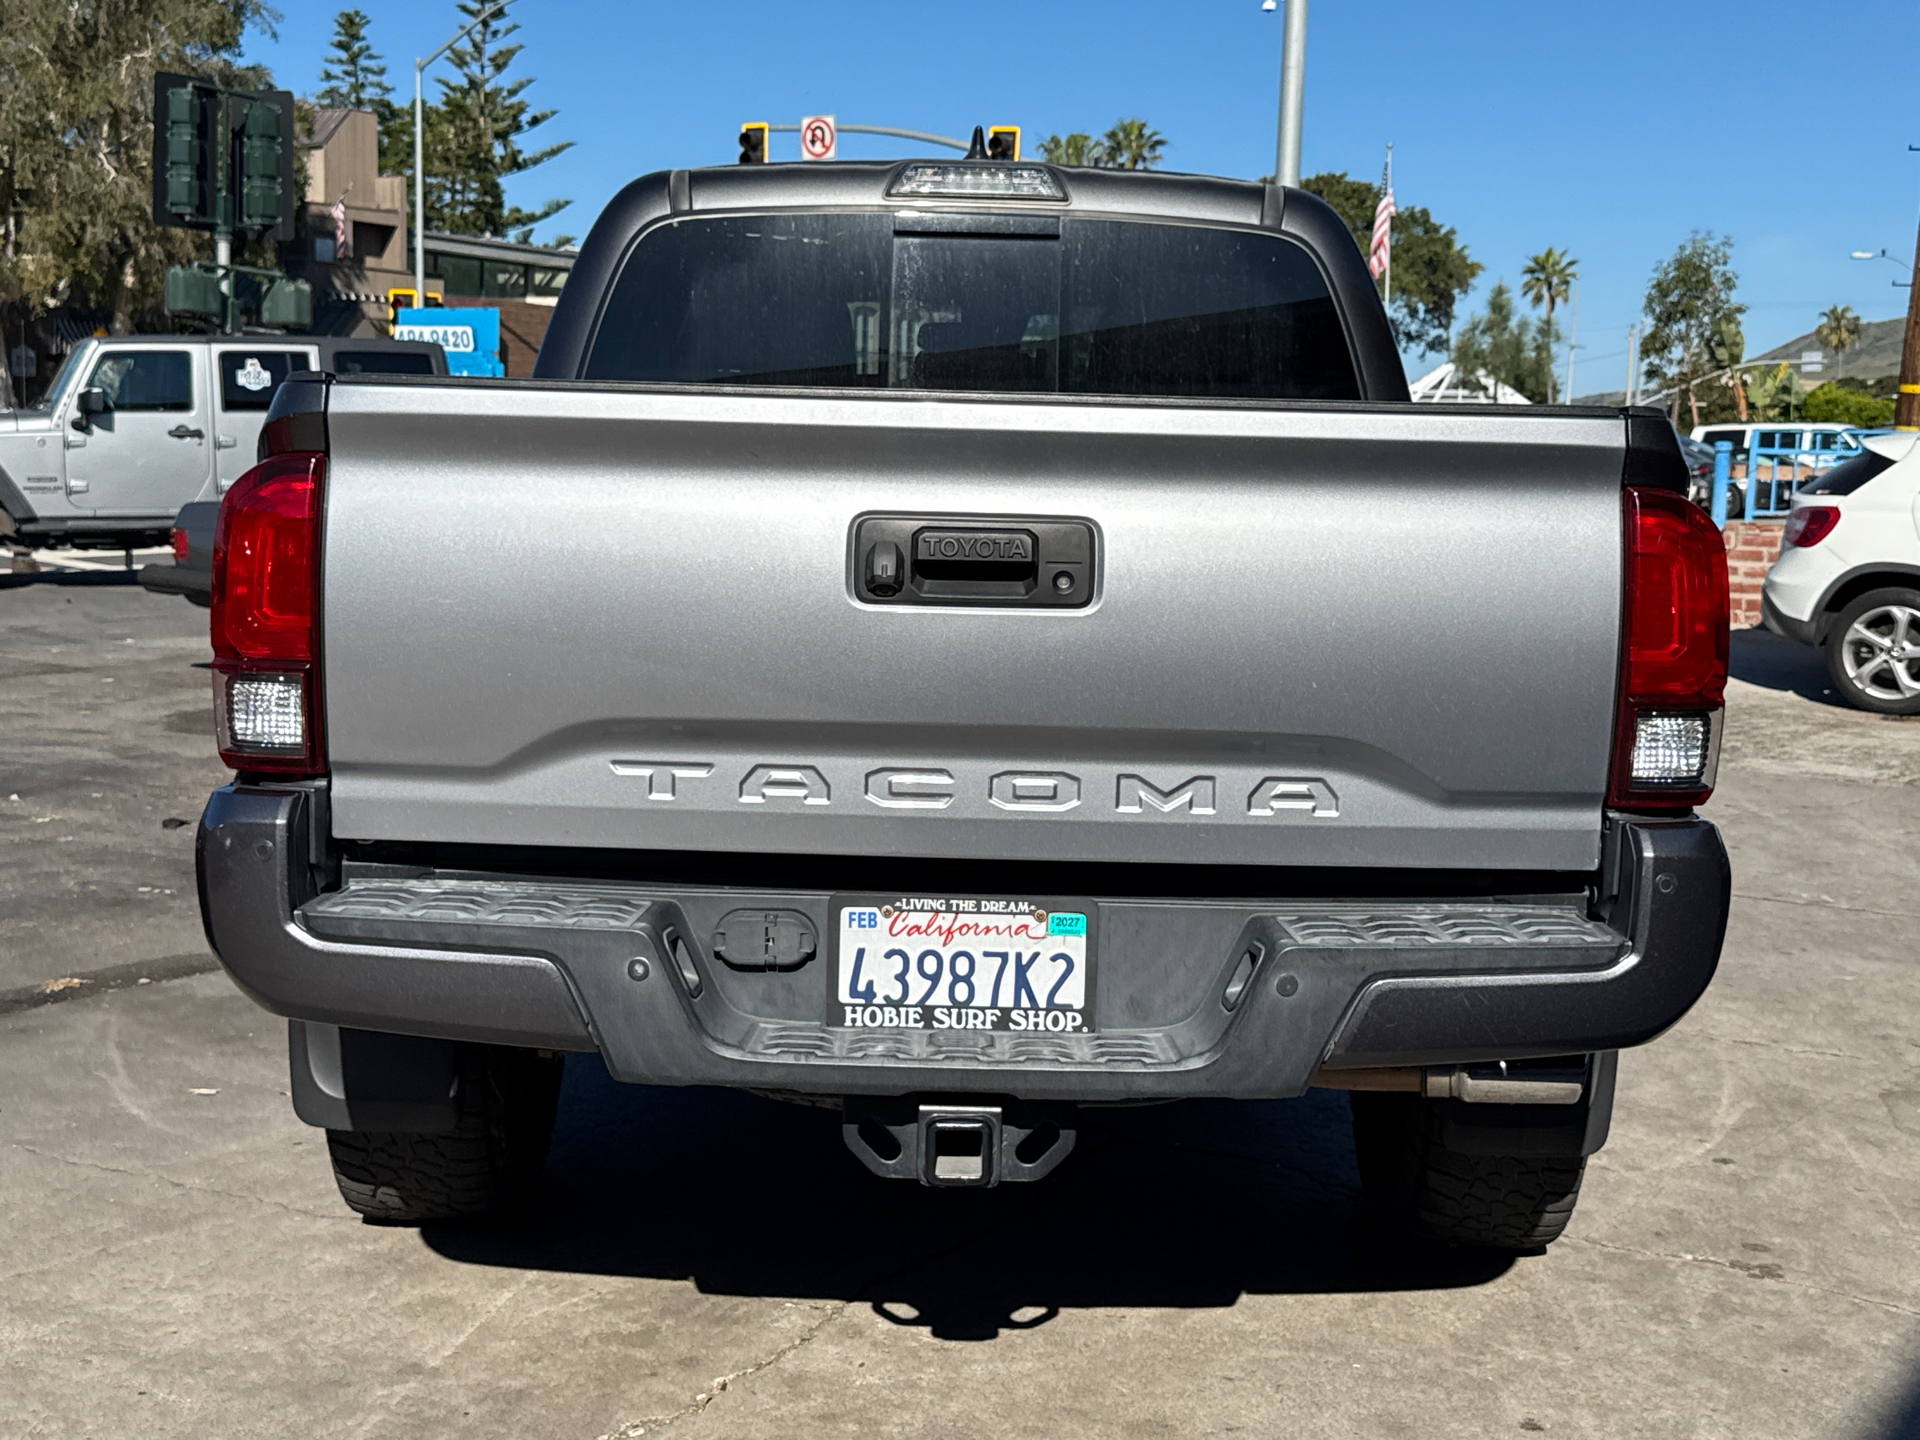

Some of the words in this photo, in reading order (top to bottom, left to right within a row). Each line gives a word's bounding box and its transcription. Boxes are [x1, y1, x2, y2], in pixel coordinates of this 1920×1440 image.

[924, 537, 1027, 559] TOYOTA
[609, 760, 1341, 817] TACOMA
[902, 899, 946, 911] LIVING
[949, 900, 977, 911] THE
[981, 901, 1029, 912] DREAM
[849, 911, 877, 928] FEB
[889, 912, 1047, 947] California
[1055, 916, 1080, 927] 2027
[849, 948, 1075, 1007] 43987K2
[843, 1006, 924, 1028] HOBIE
[932, 1008, 1000, 1029] SURF
